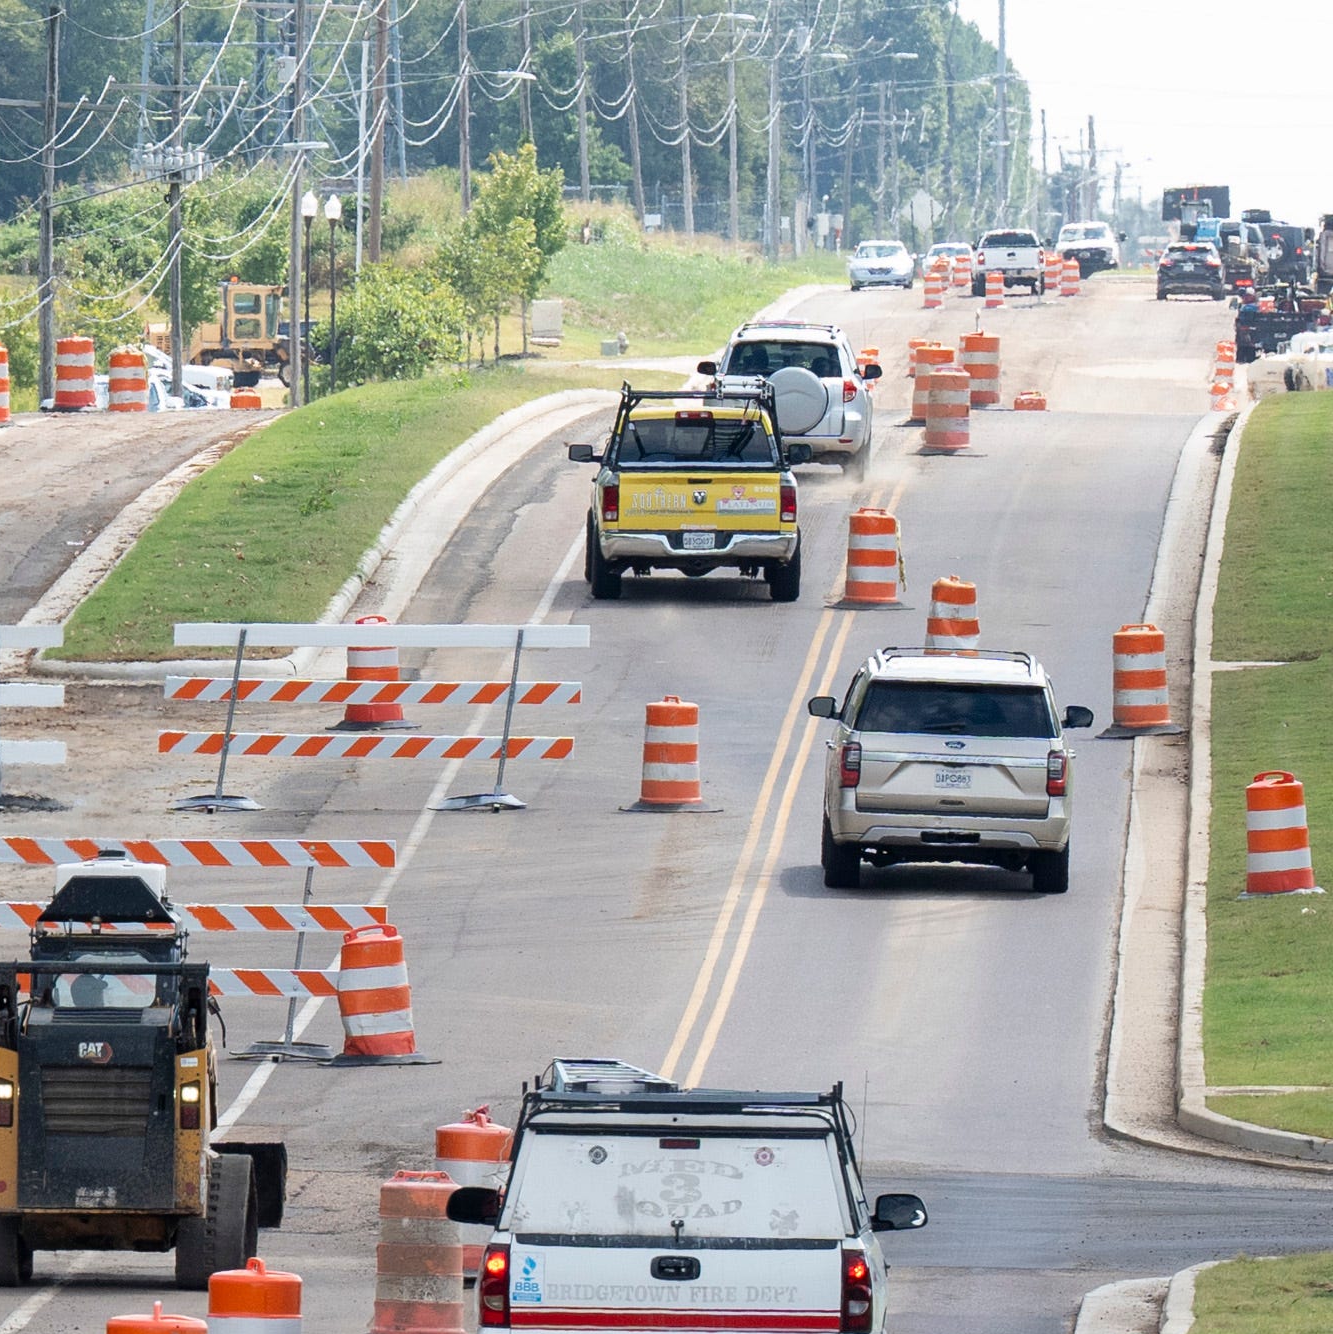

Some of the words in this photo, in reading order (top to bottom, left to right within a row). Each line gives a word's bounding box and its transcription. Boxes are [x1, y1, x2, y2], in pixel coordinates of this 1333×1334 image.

[78, 1042, 104, 1058] CAT
[659, 1173, 702, 1203] 3
[622, 1198, 743, 1219] QUAD
[514, 1281, 540, 1292] BBB
[546, 1283, 681, 1302] BRIDGETOWN
[689, 1286, 738, 1303] FIRE
